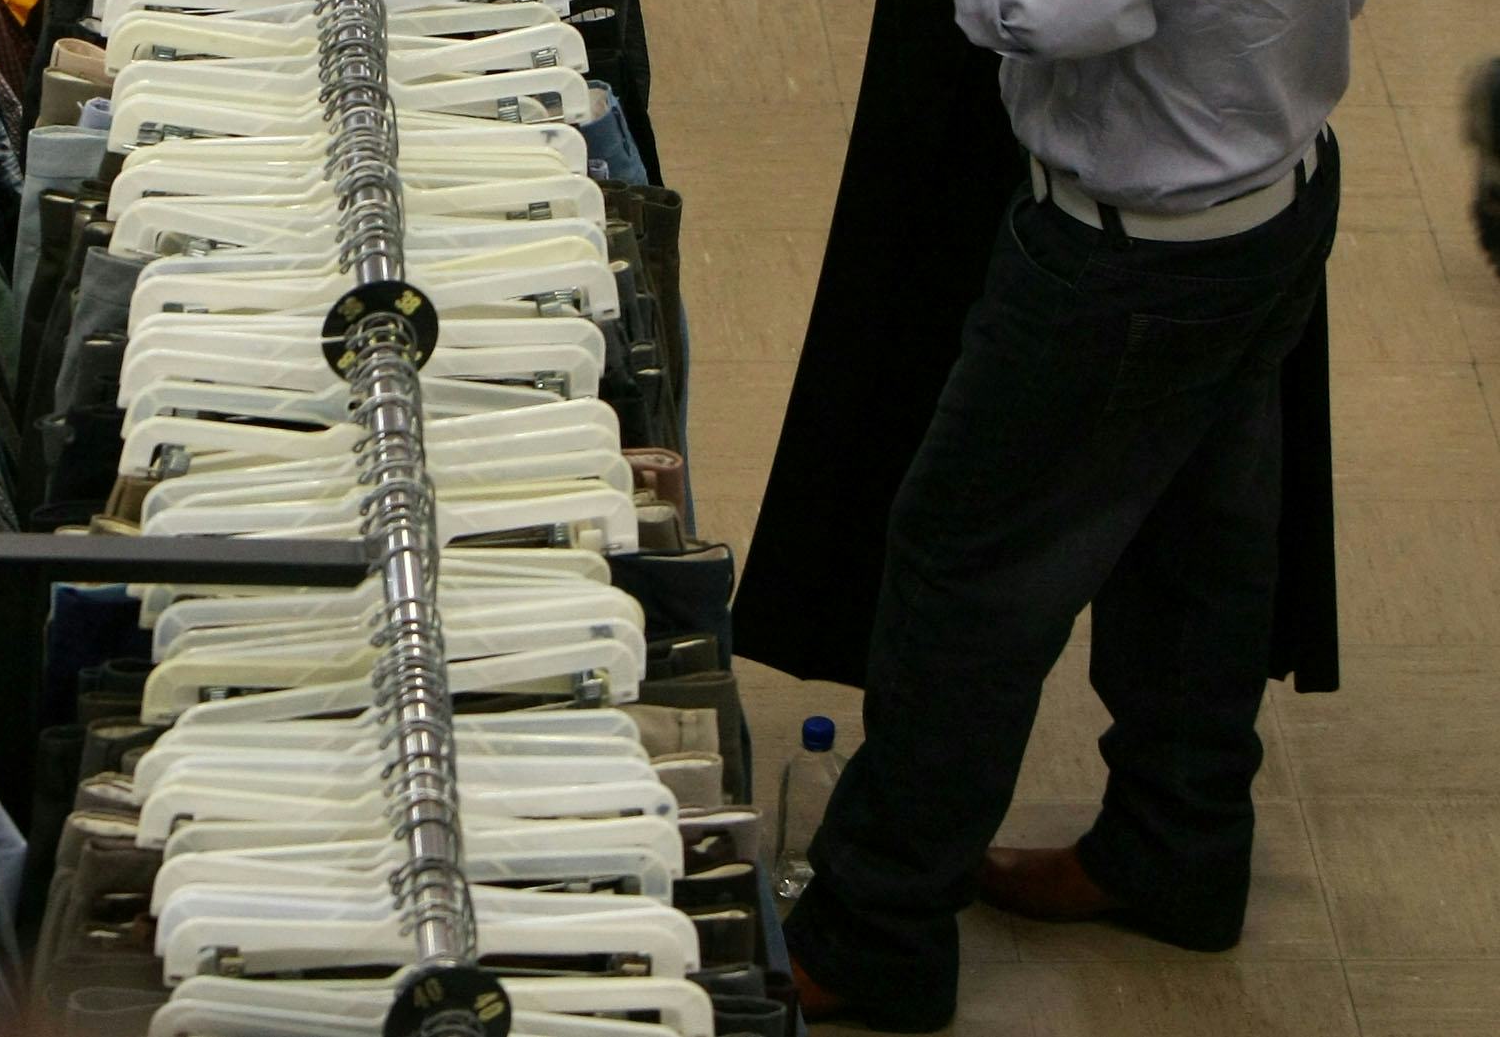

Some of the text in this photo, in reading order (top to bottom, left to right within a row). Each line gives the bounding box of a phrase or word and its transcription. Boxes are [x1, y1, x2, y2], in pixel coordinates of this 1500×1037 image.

[395, 290, 421, 315] 38
[414, 978, 443, 1007] 40
[474, 992, 504, 1022] 40
